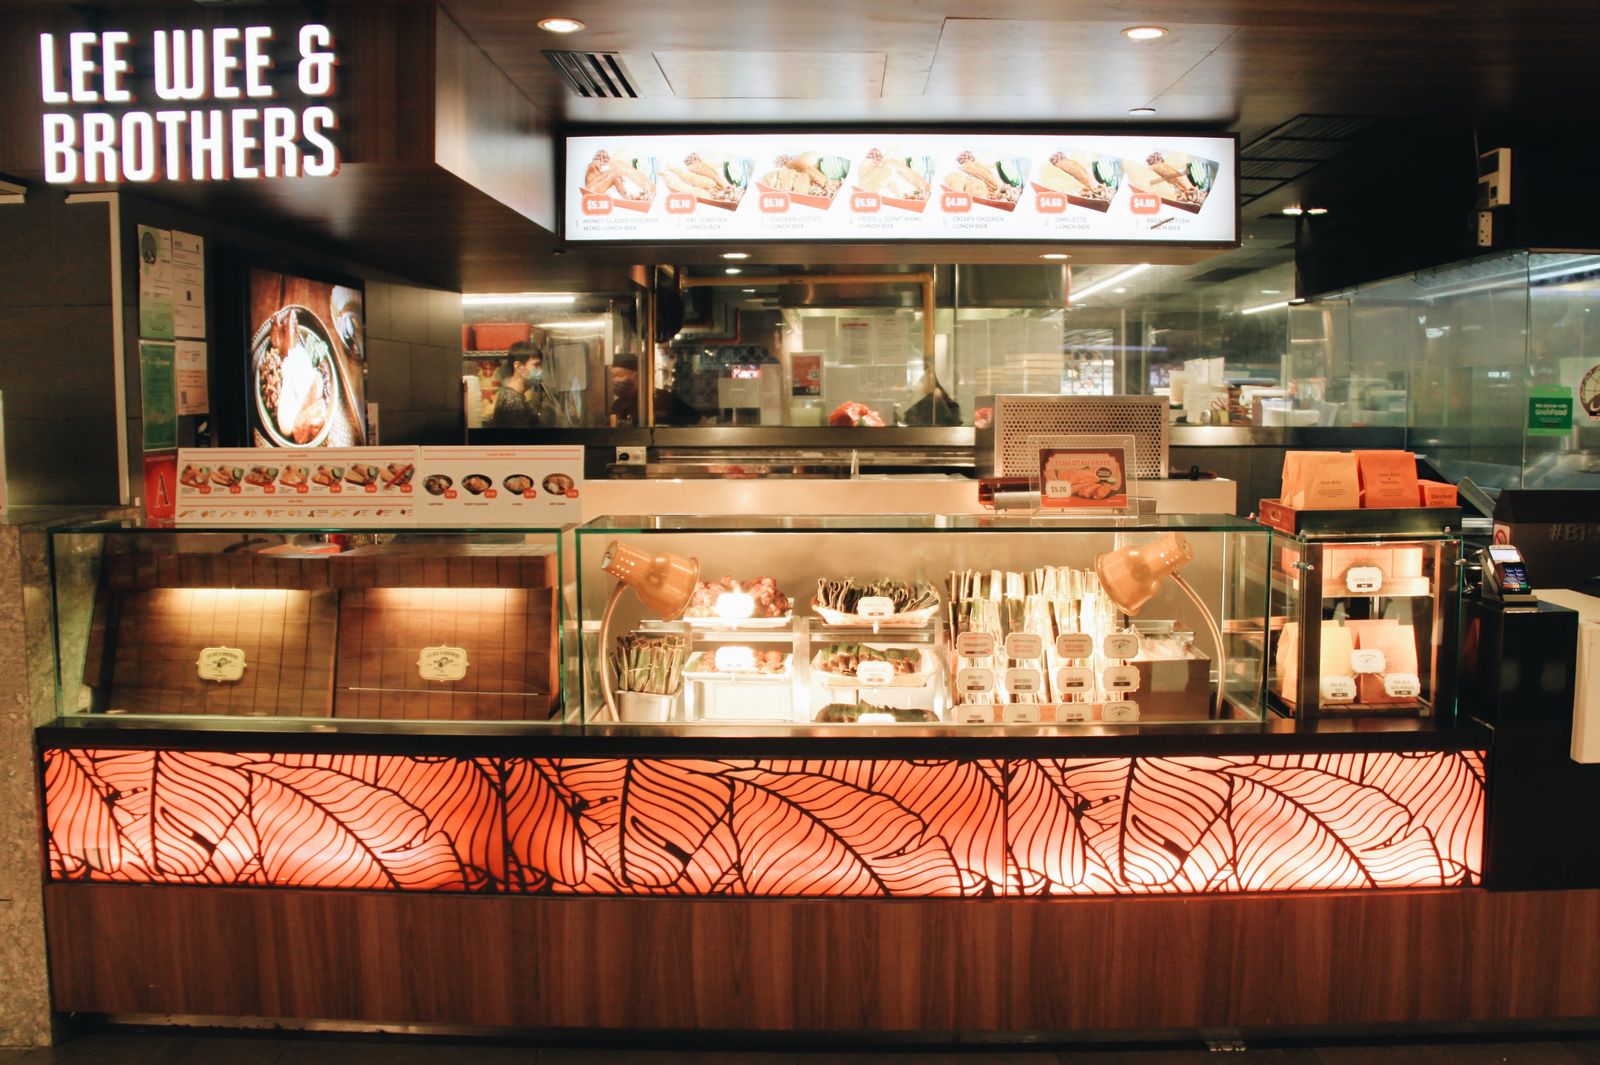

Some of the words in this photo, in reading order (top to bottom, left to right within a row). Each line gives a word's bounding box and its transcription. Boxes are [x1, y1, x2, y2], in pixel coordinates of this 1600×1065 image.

[40, 31, 131, 103] LEE
[154, 26, 273, 100] WEE
[298, 24, 336, 97] &
[43, 106, 338, 184] BROTHERS
[153, 472, 171, 508] A
[1050, 485, 1067, 494] $5.20
